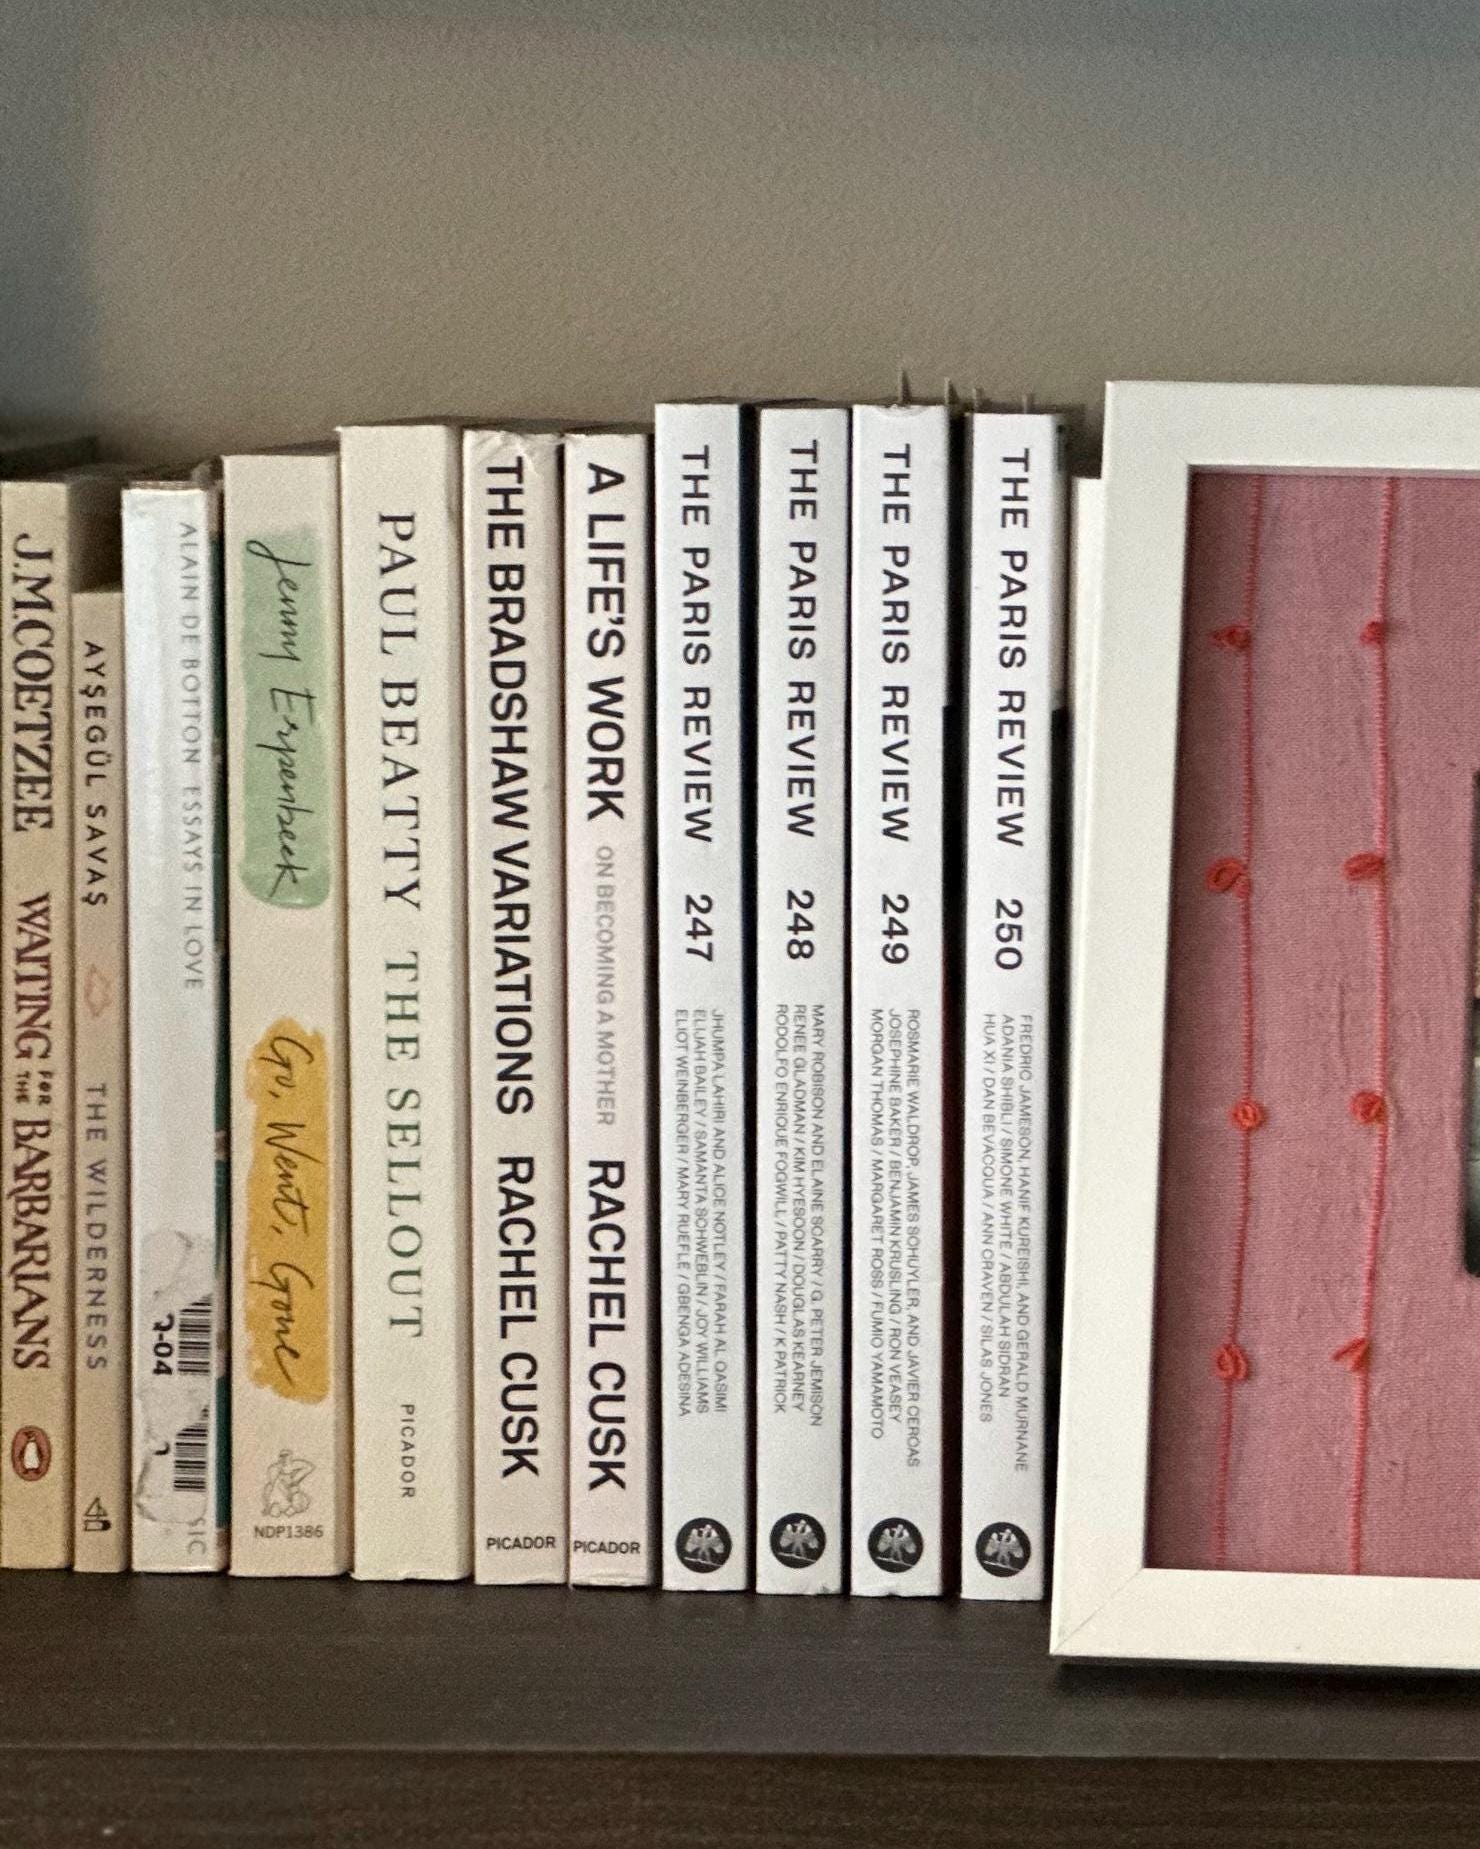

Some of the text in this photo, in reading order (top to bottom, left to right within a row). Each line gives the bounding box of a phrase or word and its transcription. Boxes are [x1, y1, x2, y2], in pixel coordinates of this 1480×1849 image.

[588, 463, 625, 495] A
[13, 533, 55, 831] J.M.COETZEE
[79, 641, 112, 906] AYŞEGÜL SAVAŞ
[180, 522, 205, 989] ALAIN DE BOTTON ESSAYS IN LOVE
[245, 539, 318, 898] Jenny Erpenbeck
[379, 513, 421, 911] PAUL BEATTY
[487, 457, 534, 1115] THE BRADSHAW VARIATIONS
[588, 676, 624, 821] WORK
[683, 445, 713, 963] THE PARIS REVIEW 247
[787, 440, 818, 961] THE PARIS REVIEW 248
[881, 444, 911, 965] THE PARIS REVIEW 249
[994, 449, 1029, 970] THE PARIS REVIEW 250
[14, 892, 52, 1058] WAITING
[16, 1072, 30, 1104] THE
[39, 1071, 51, 1105] FOR
[385, 951, 424, 1338] THE SELLOUT
[596, 846, 616, 1125] ON BECOMING A MOTHER
[7, 1119, 51, 1369] BARBARIANS
[85, 1084, 108, 1370] THE WILDERNESS
[251, 1036, 324, 1387] Go, Went, Gone
[498, 1157, 539, 1478] RACHEL CUSK
[589, 1160, 626, 1491] RACHEL CUSK
[711, 1009, 727, 1411] JHUMPA LAHIRI AND ALICE NOTLEY FARAH AL QASIMI
[774, 1004, 788, 1413] RODOLFO ENRIQUE FOGWILL PATTY NASH K PATRICK
[810, 1004, 824, 1426] MARY ROBISON AND ELAINE SCARRY G. PETER JEMISON
[871, 1009, 884, 1439] MORGAN THOMAS MARGARET ROSS FUMIO YAMAMOTO
[888, 1009, 902, 1423] JOSEPHINE BAKER BENJAMIN KRUSLING RON VEASEY
[979, 1014, 996, 1422] HUA XI DAN BEVACQUA ANN CRAVEN SILAS JONES
[997, 1014, 1014, 1397] ADANIA SHIBLI SIMONE WHITE ABDULAH SIDRAN
[254, 1525, 324, 1539] NDP1386
[400, 1403, 416, 1498] PICADOR
[486, 1536, 557, 1550] PICADOR
[573, 1541, 642, 1554] PICADOR
